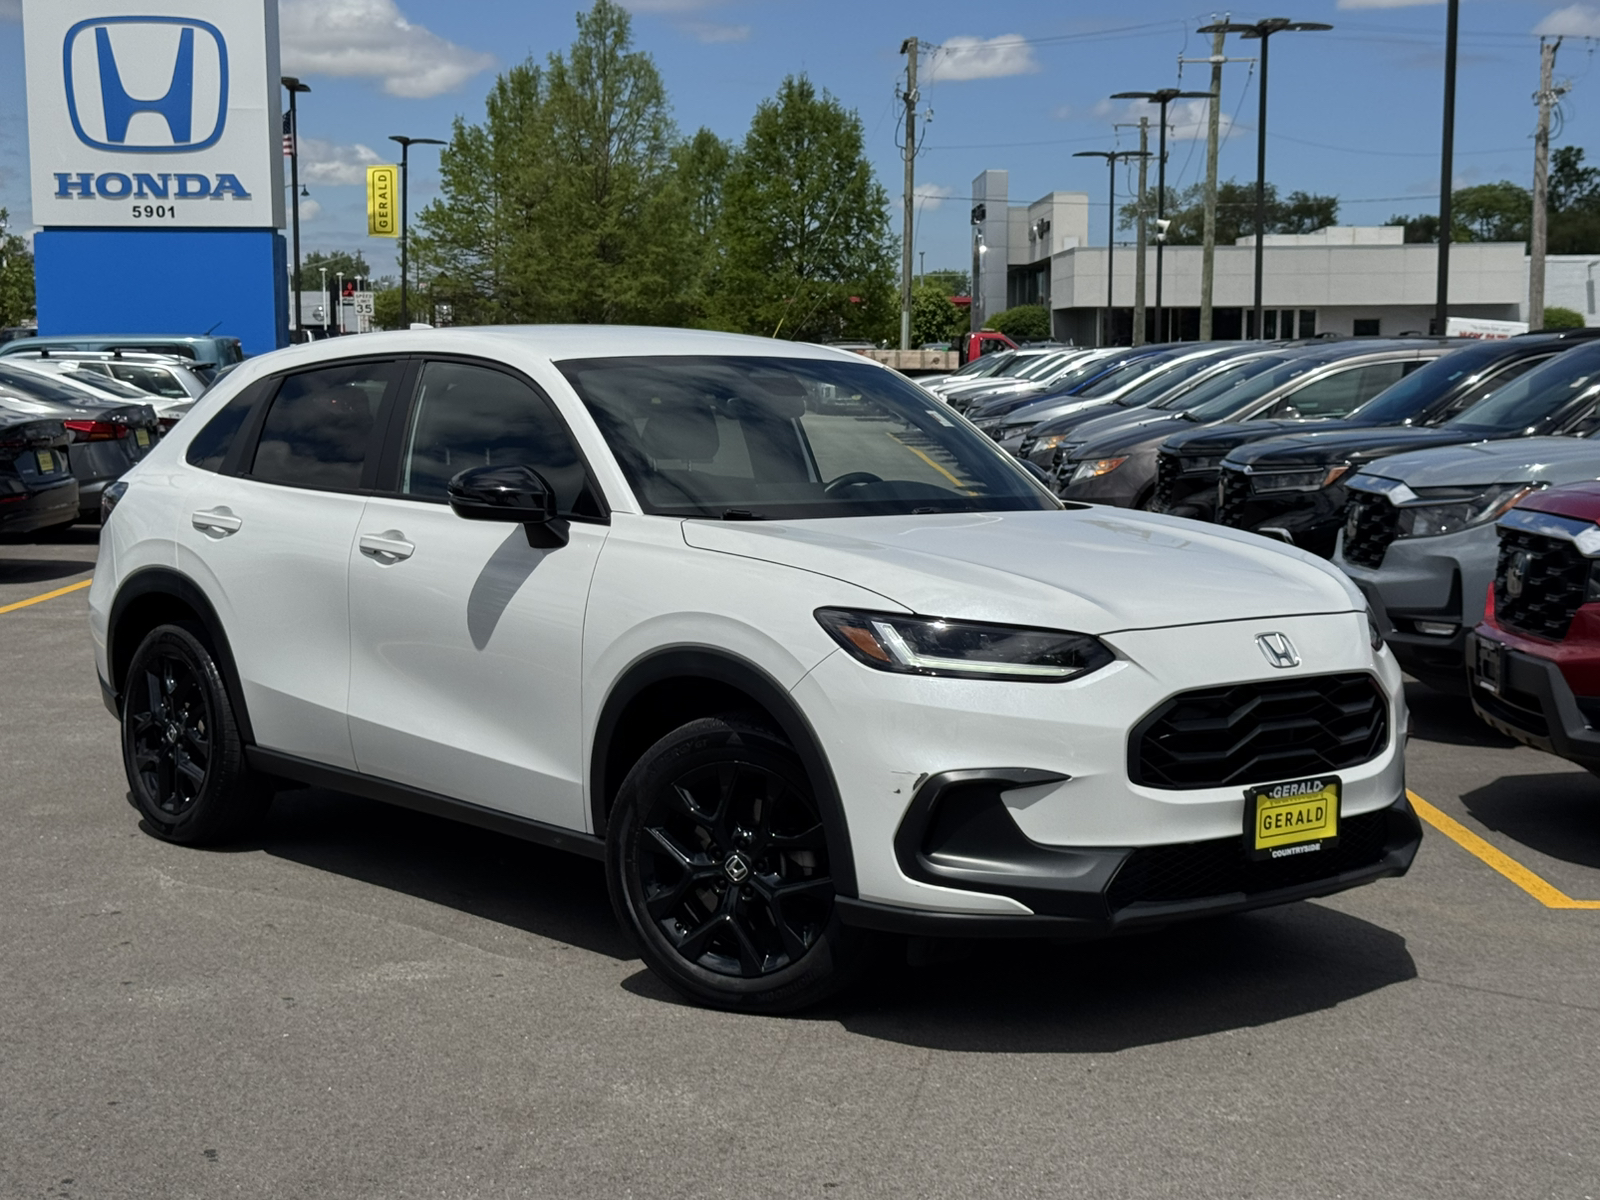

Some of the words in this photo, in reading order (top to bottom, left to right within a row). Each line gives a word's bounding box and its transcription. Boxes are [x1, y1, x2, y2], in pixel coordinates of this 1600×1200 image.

[53, 172, 252, 200] HONDA
[378, 174, 388, 229] GERALD
[132, 205, 176, 219] 5901
[356, 304, 373, 314] 35
[1273, 780, 1321, 798] GERALD
[1263, 806, 1324, 830] GERALD
[1272, 843, 1321, 858] COUNTRYSIDE
